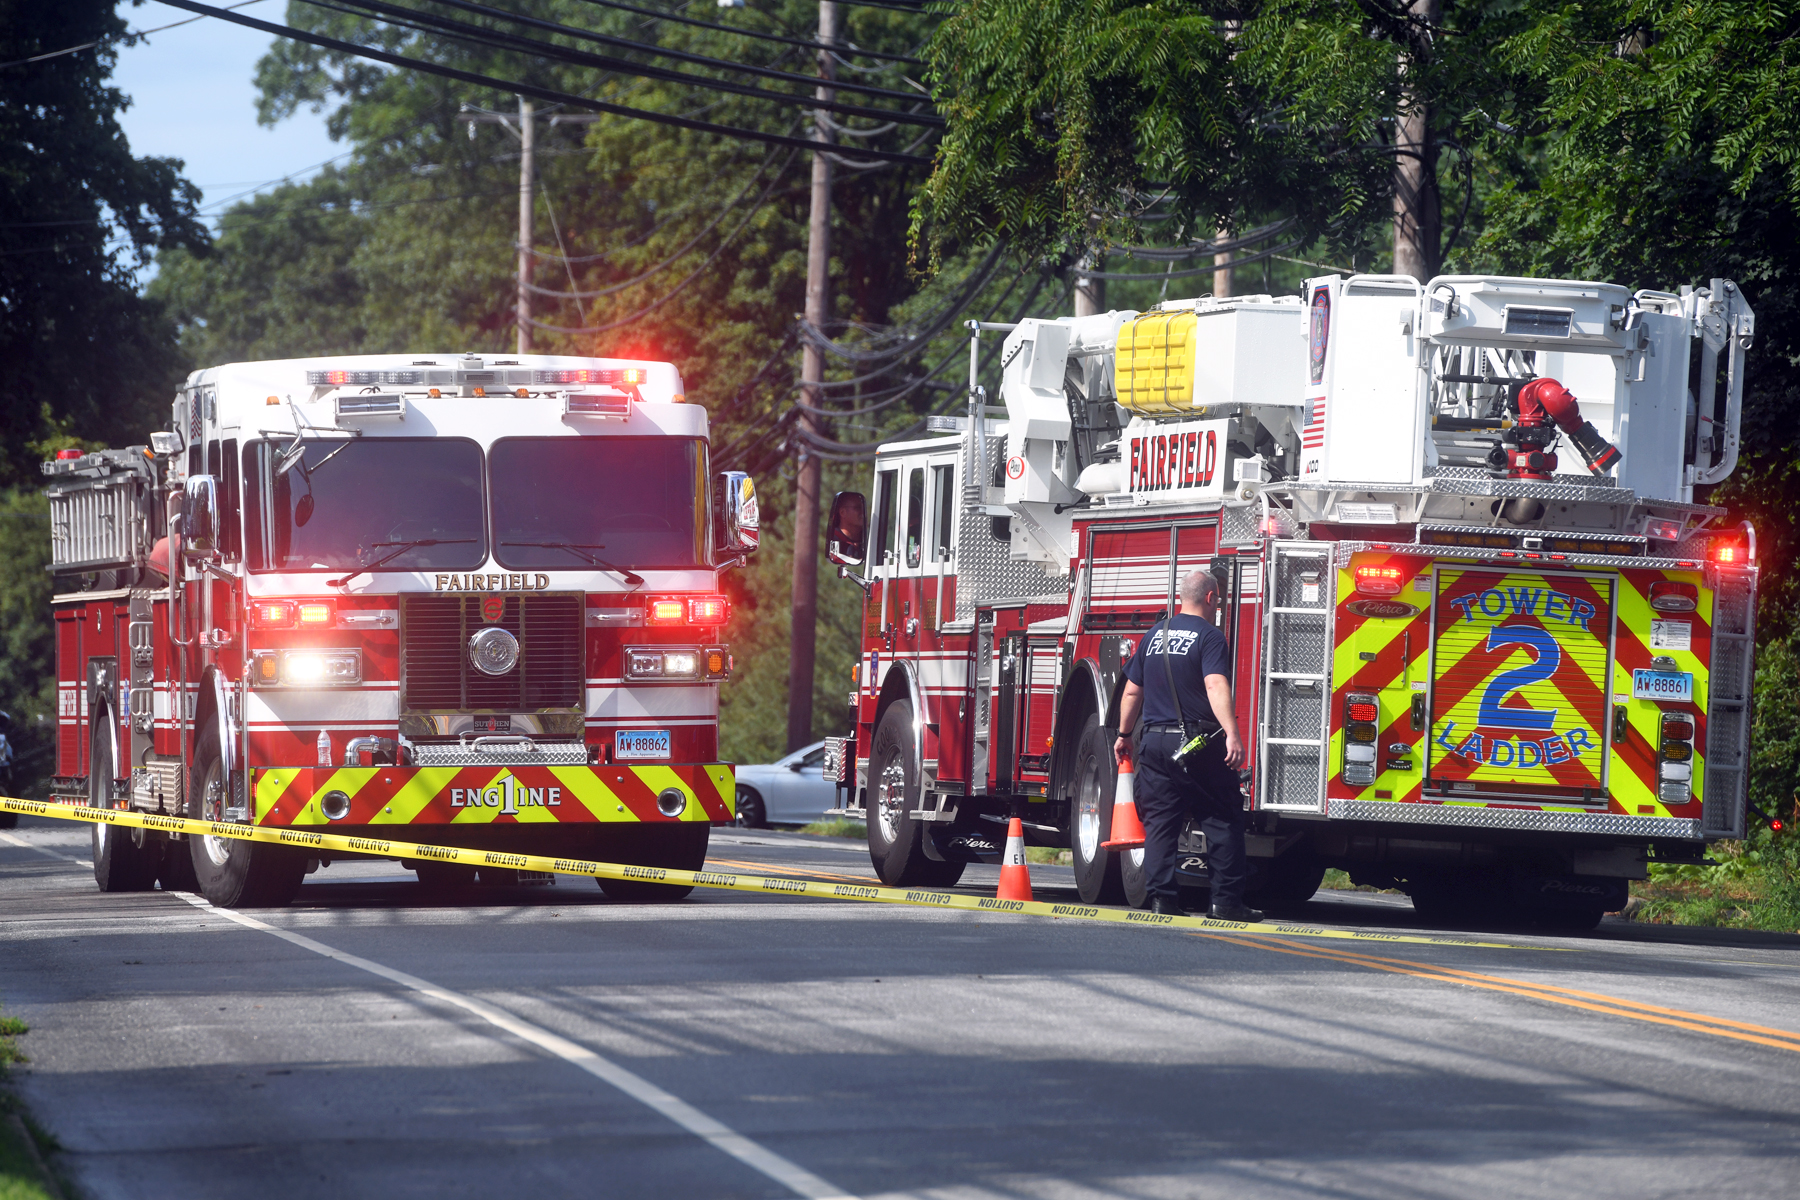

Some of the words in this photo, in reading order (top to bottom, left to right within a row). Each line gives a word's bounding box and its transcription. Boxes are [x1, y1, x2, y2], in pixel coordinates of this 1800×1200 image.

[1129, 430, 1217, 492] FAIRFIELD
[435, 574, 550, 590] FAIRFIELD
[1363, 602, 1403, 616] Pierce
[1450, 587, 1596, 632] TOWER
[1477, 624, 1560, 731] 2
[474, 720, 510, 728] SUTPHEN
[1434, 719, 1597, 769] LADDER
[948, 836, 1001, 849] Pierce
[4, 799, 47, 814] CAUTION
[74, 807, 116, 822] CAUTION
[142, 815, 185, 830] CAUTION
[212, 822, 254, 837] CAUTION
[280, 830, 322, 844] CAUTION
[348, 838, 390, 852] CAUTION
[416, 846, 458, 860] CAUTION
[484, 852, 528, 867] CAUTION
[554, 860, 597, 874] CAUTION
[623, 866, 666, 880] CAUTION
[692, 873, 736, 887] CAUTION
[763, 879, 807, 892] CAUTION
[834, 886, 879, 899] CAUTION
[906, 892, 951, 904] CAUTION
[978, 898, 1024, 911] CAUTION
[1052, 906, 1099, 918] CAUTION
[1126, 912, 1174, 924] CAUTION
[1200, 920, 1249, 930] CAUTION
[1276, 926, 1324, 935] CAUTION
